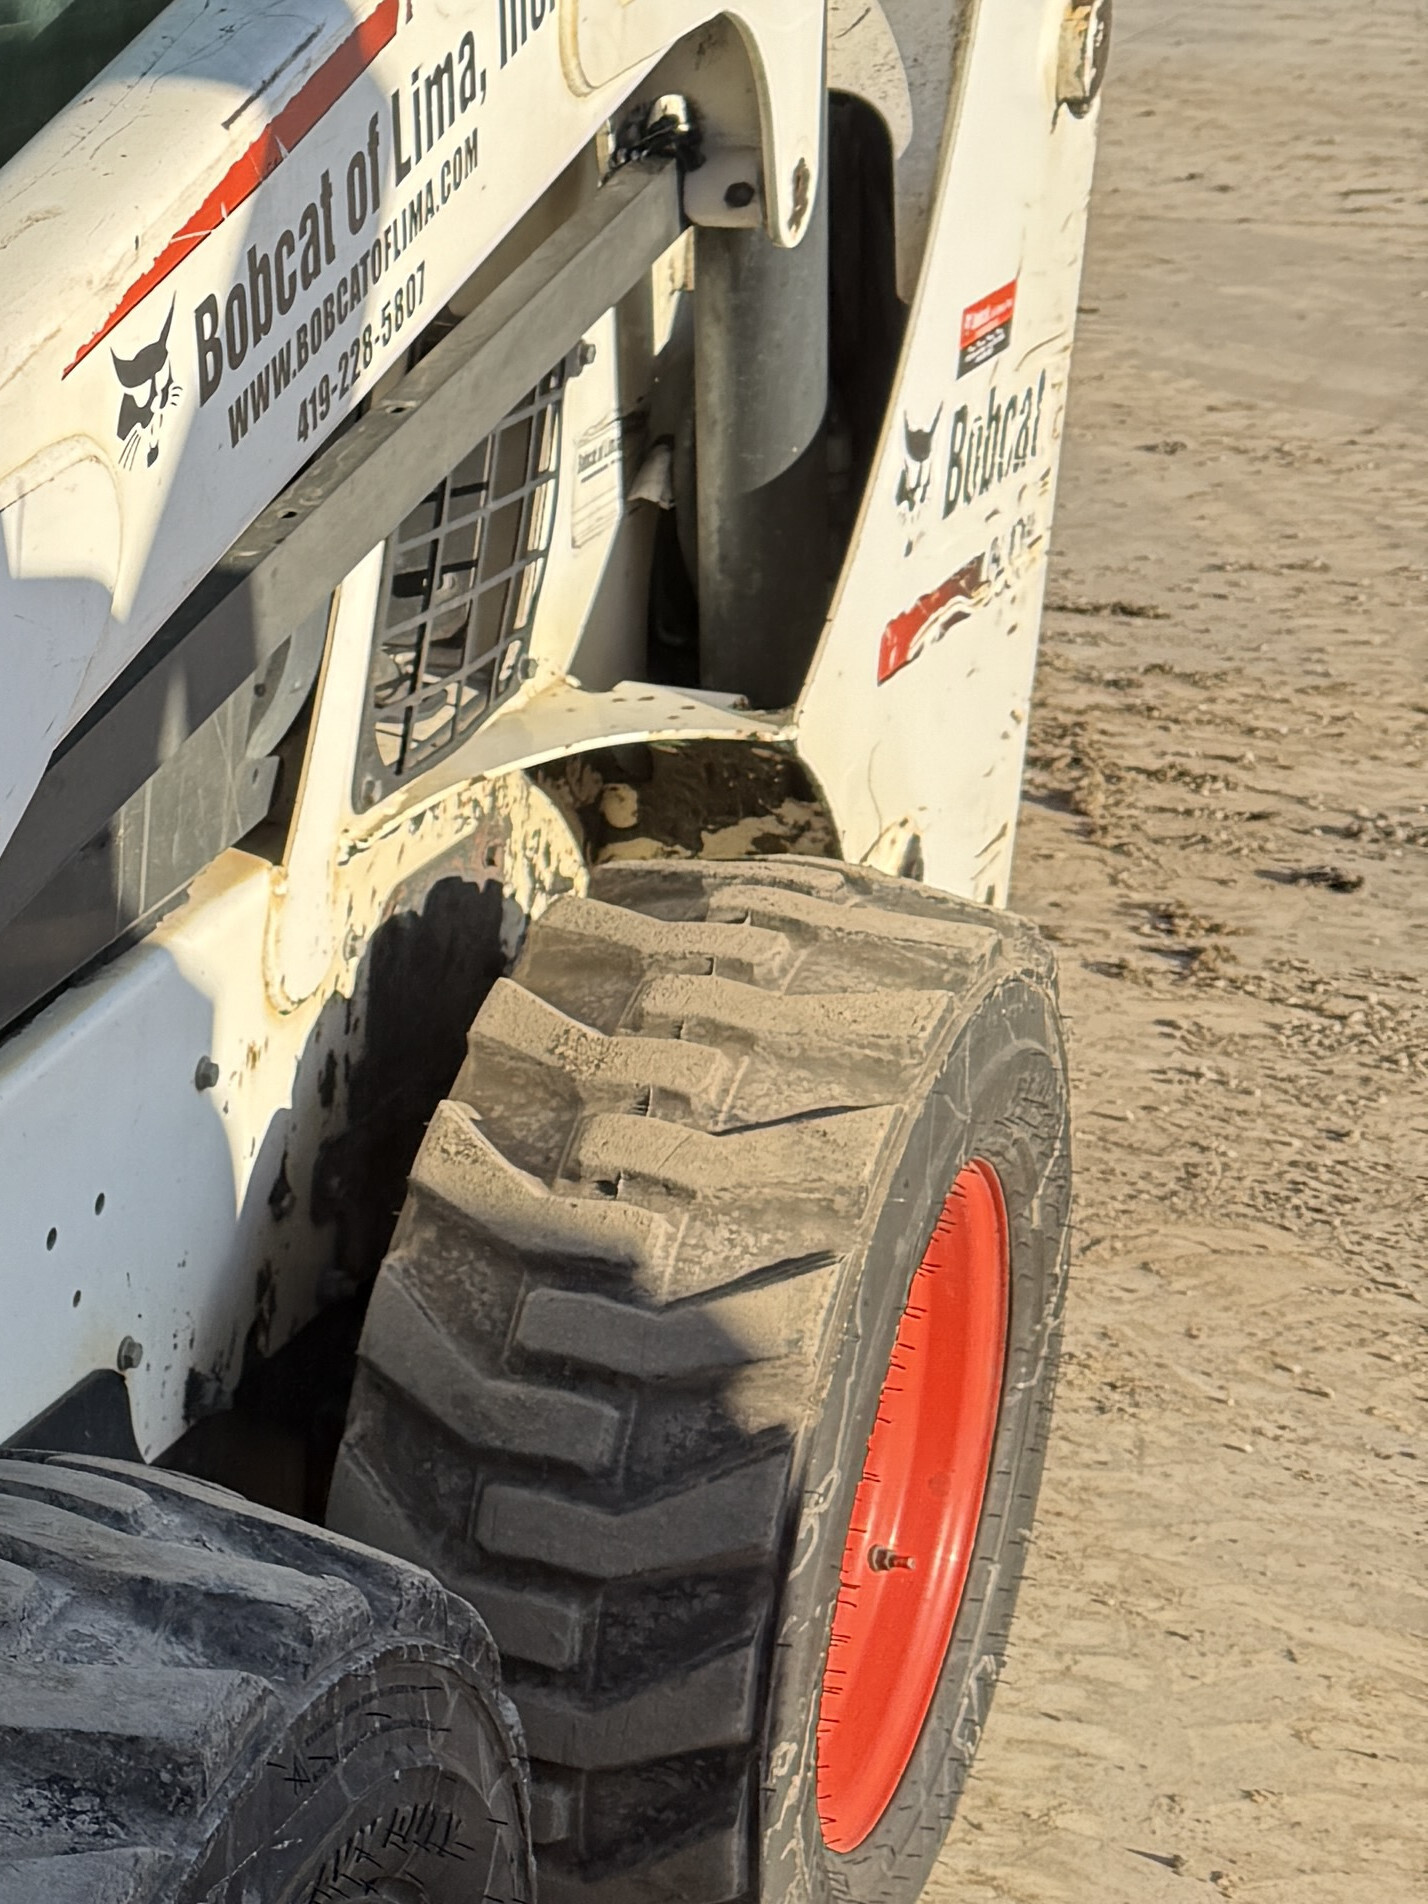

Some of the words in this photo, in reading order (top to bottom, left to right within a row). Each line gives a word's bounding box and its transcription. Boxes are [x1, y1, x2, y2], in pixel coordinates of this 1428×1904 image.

[194, 169, 336, 407] Bobcat
[347, 111, 381, 236] of
[391, 30, 488, 188] Lima,
[228, 128, 479, 448] WWW.BOBCATOFLIMA.COM
[297, 260, 426, 443] 419-228-5807
